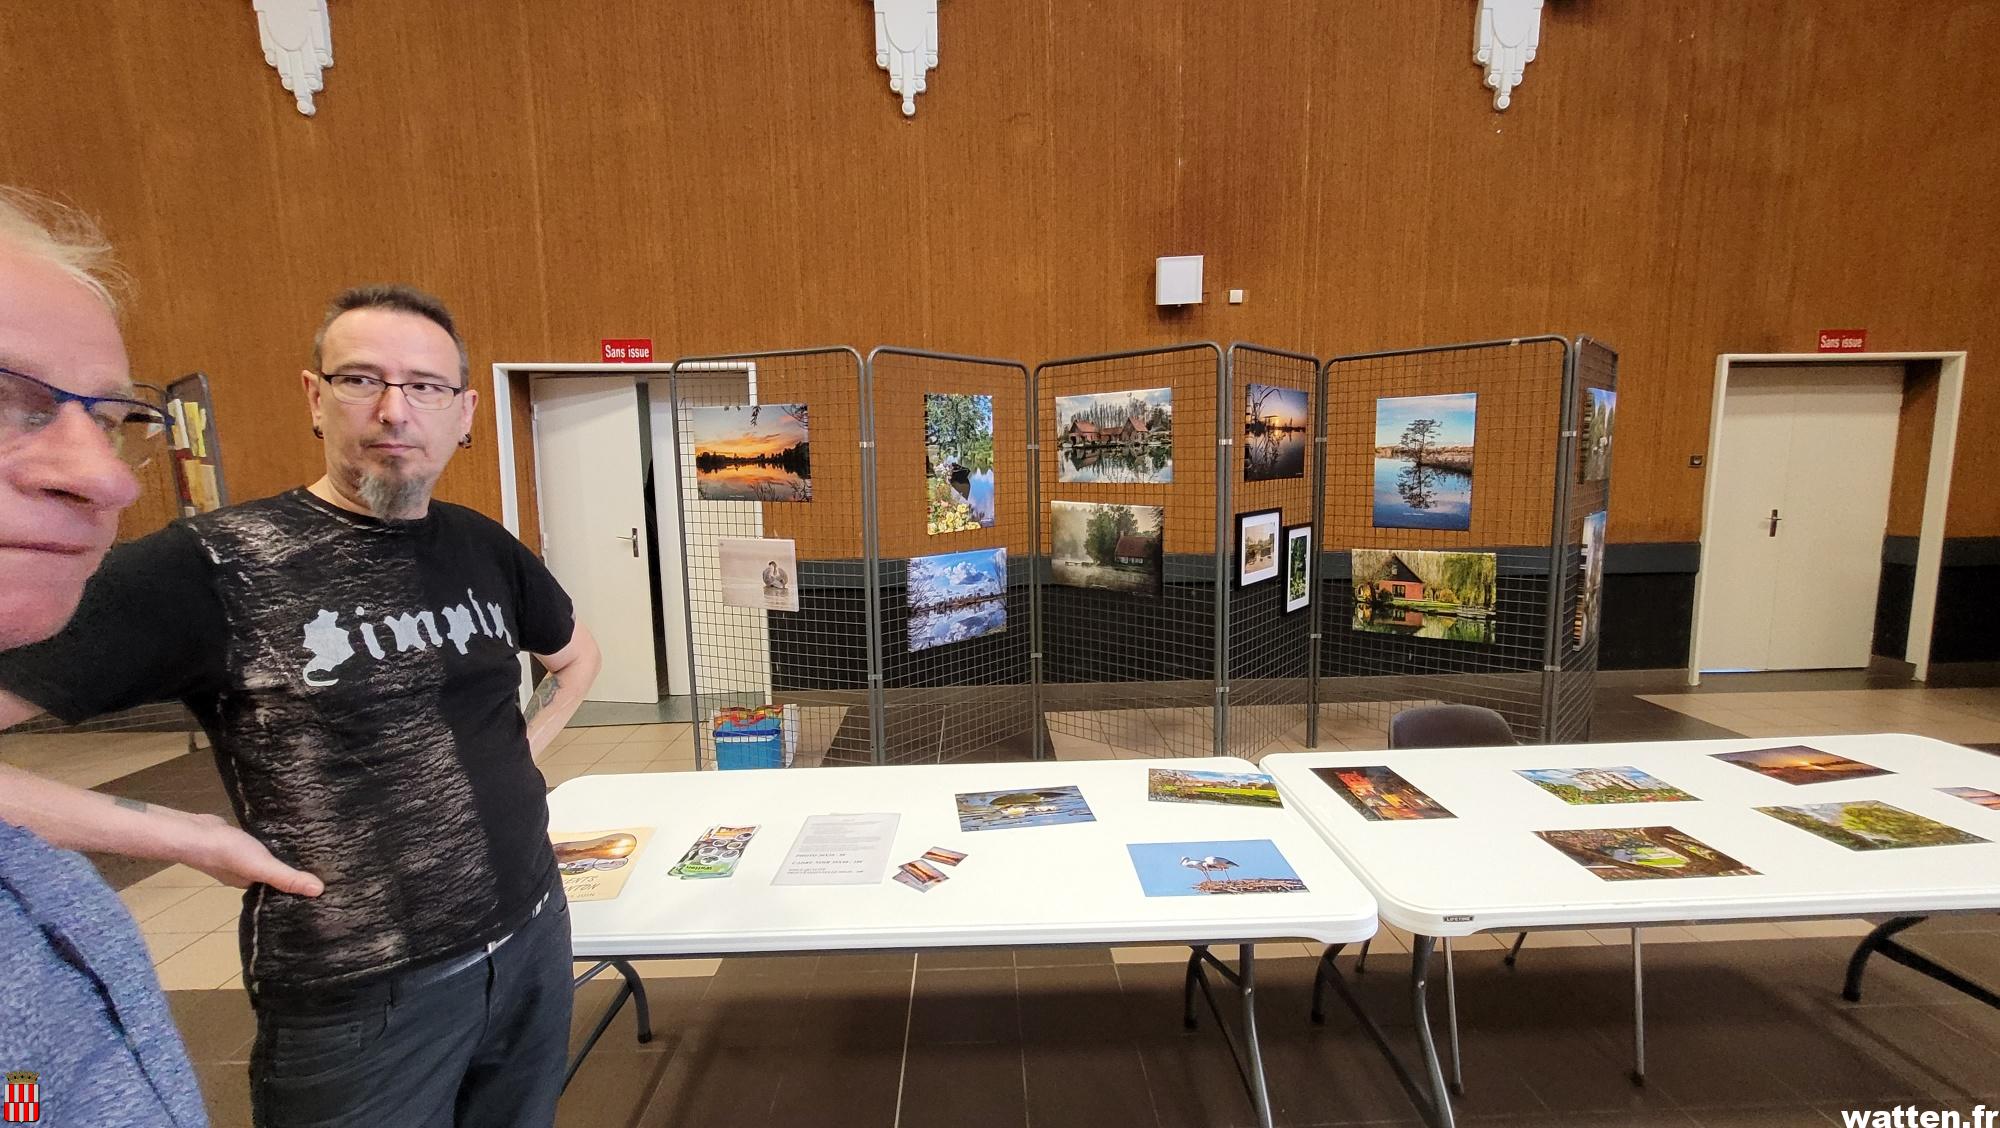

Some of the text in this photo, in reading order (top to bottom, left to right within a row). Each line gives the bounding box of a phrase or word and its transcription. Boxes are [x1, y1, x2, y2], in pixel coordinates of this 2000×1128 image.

[1820, 335, 1862, 348] Sans issue
[605, 344, 650, 358] Sans issue
